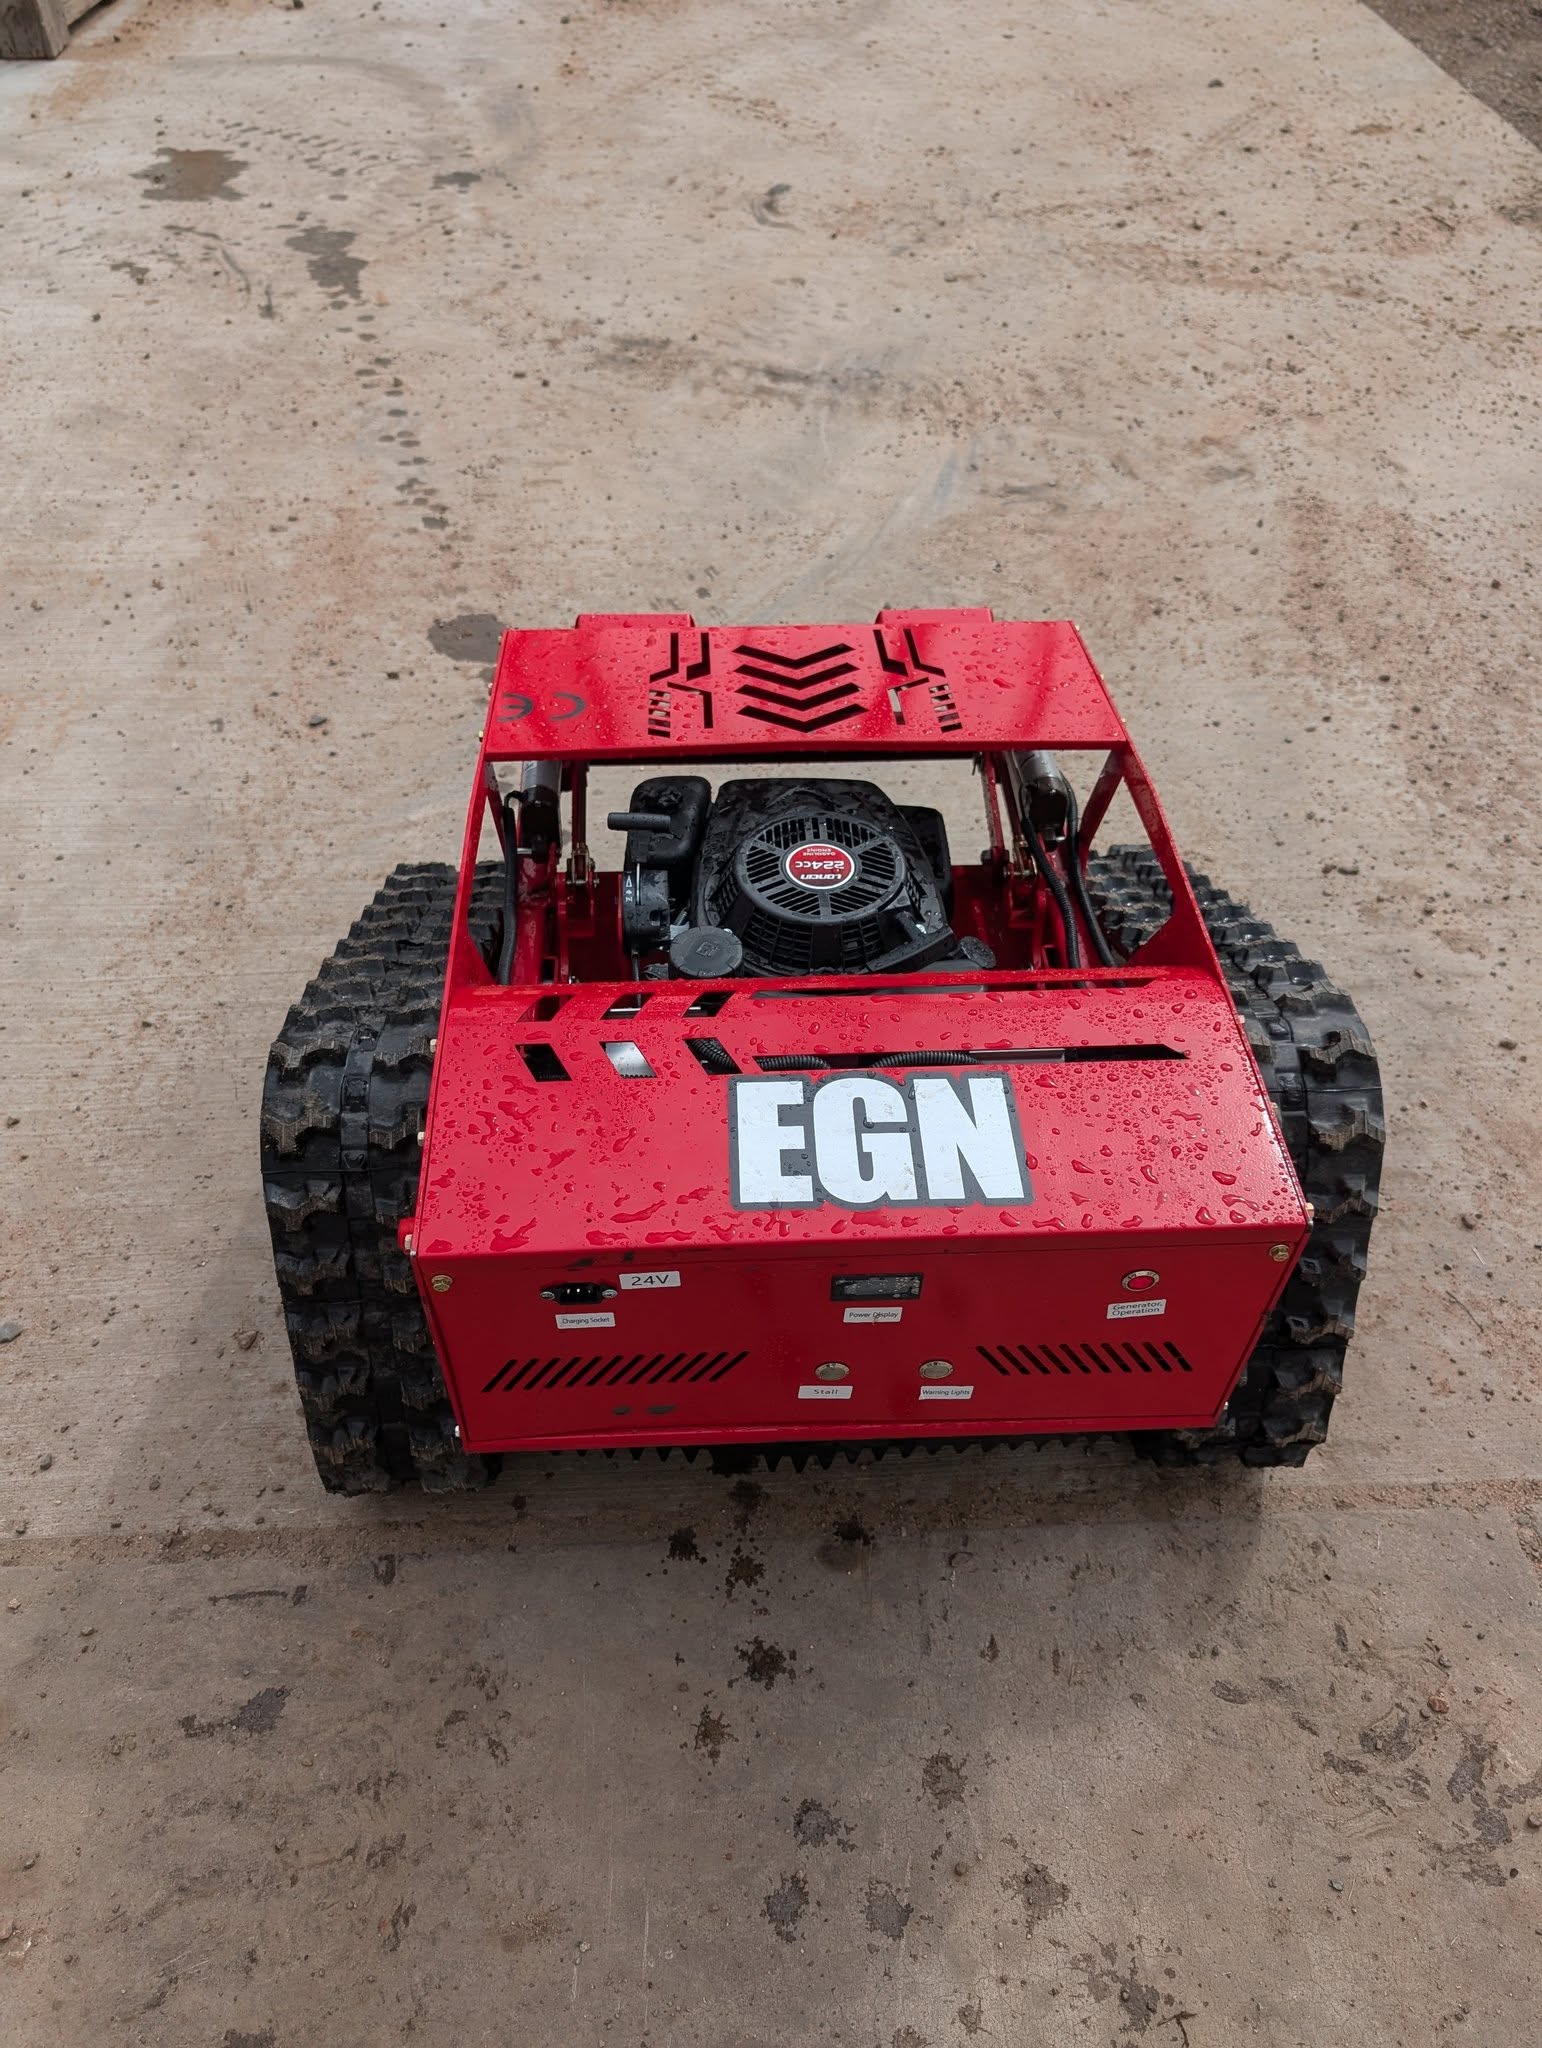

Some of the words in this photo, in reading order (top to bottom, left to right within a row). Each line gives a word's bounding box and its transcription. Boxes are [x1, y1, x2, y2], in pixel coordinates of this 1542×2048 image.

[736, 1077, 1025, 1204] EGN
[631, 1274, 669, 1287] 24V
[872, 1311, 899, 1319] Display
[1112, 1308, 1160, 1316] Operation
[562, 1317, 589, 1325] Charging
[814, 1388, 838, 1396] Stall
